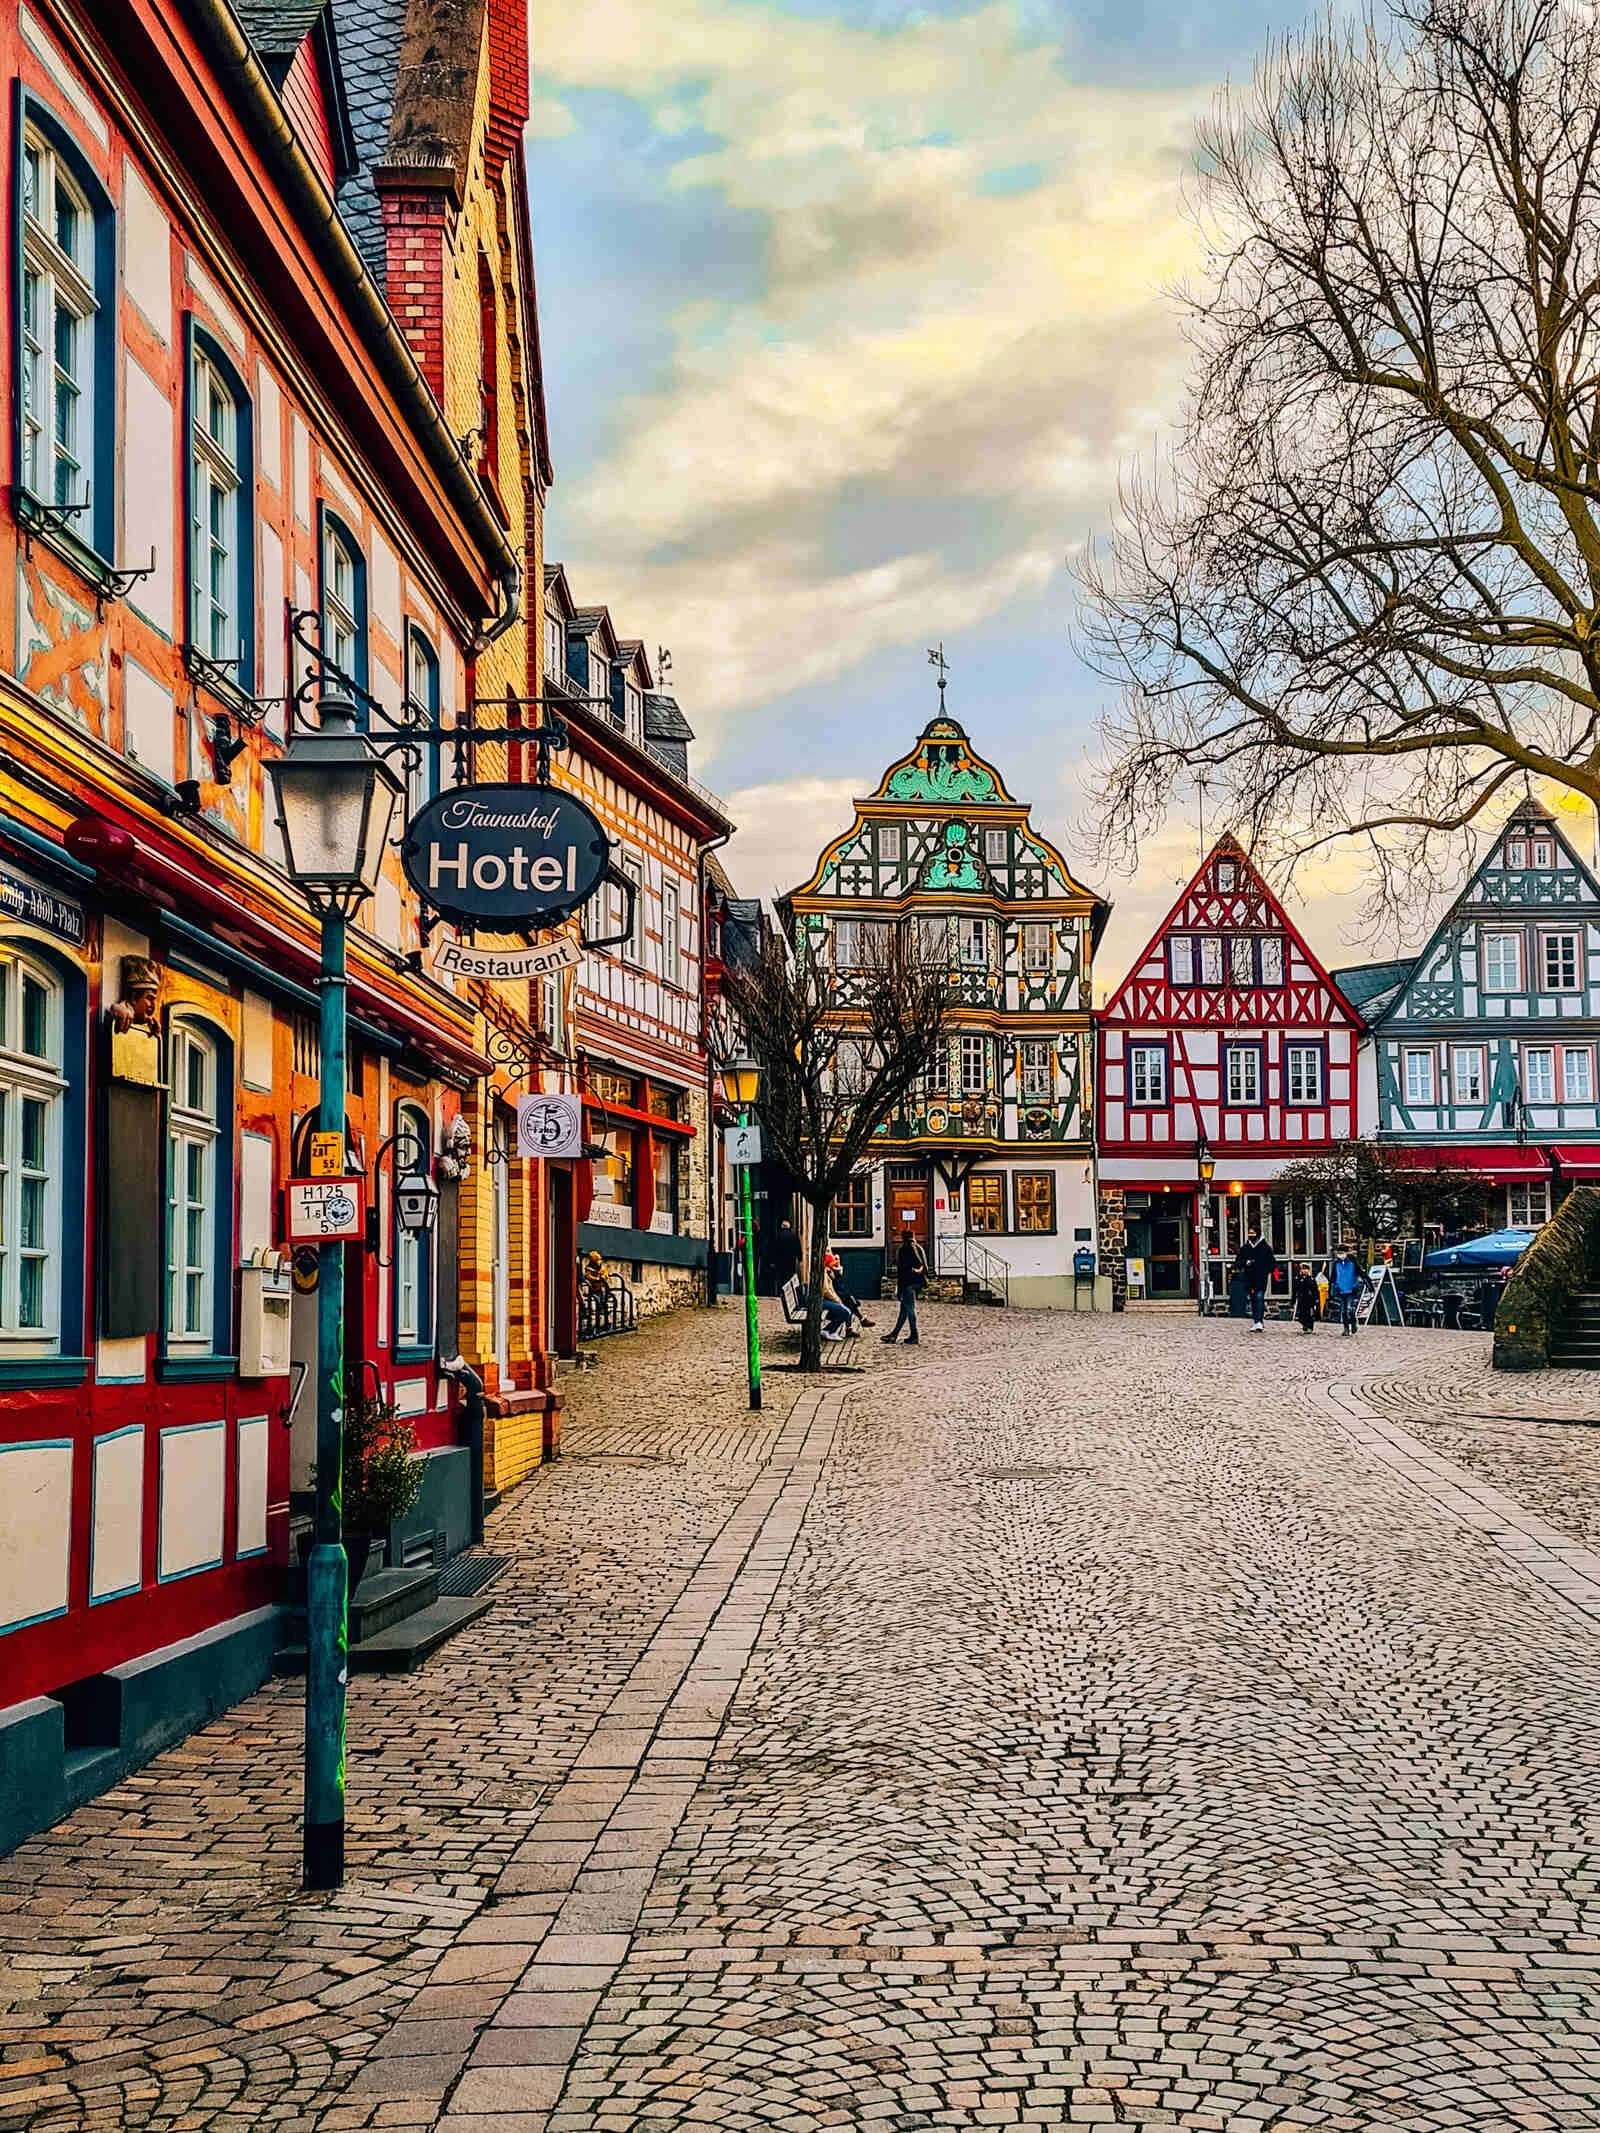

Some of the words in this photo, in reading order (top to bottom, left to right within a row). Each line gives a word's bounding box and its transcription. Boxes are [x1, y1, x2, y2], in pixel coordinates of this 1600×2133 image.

[441, 799, 561, 839] Taunushof
[428, 841, 577, 892] Hotel
[0, 874, 81, 936] önig-Adolf-Platz
[441, 946, 571, 976] Restaurant
